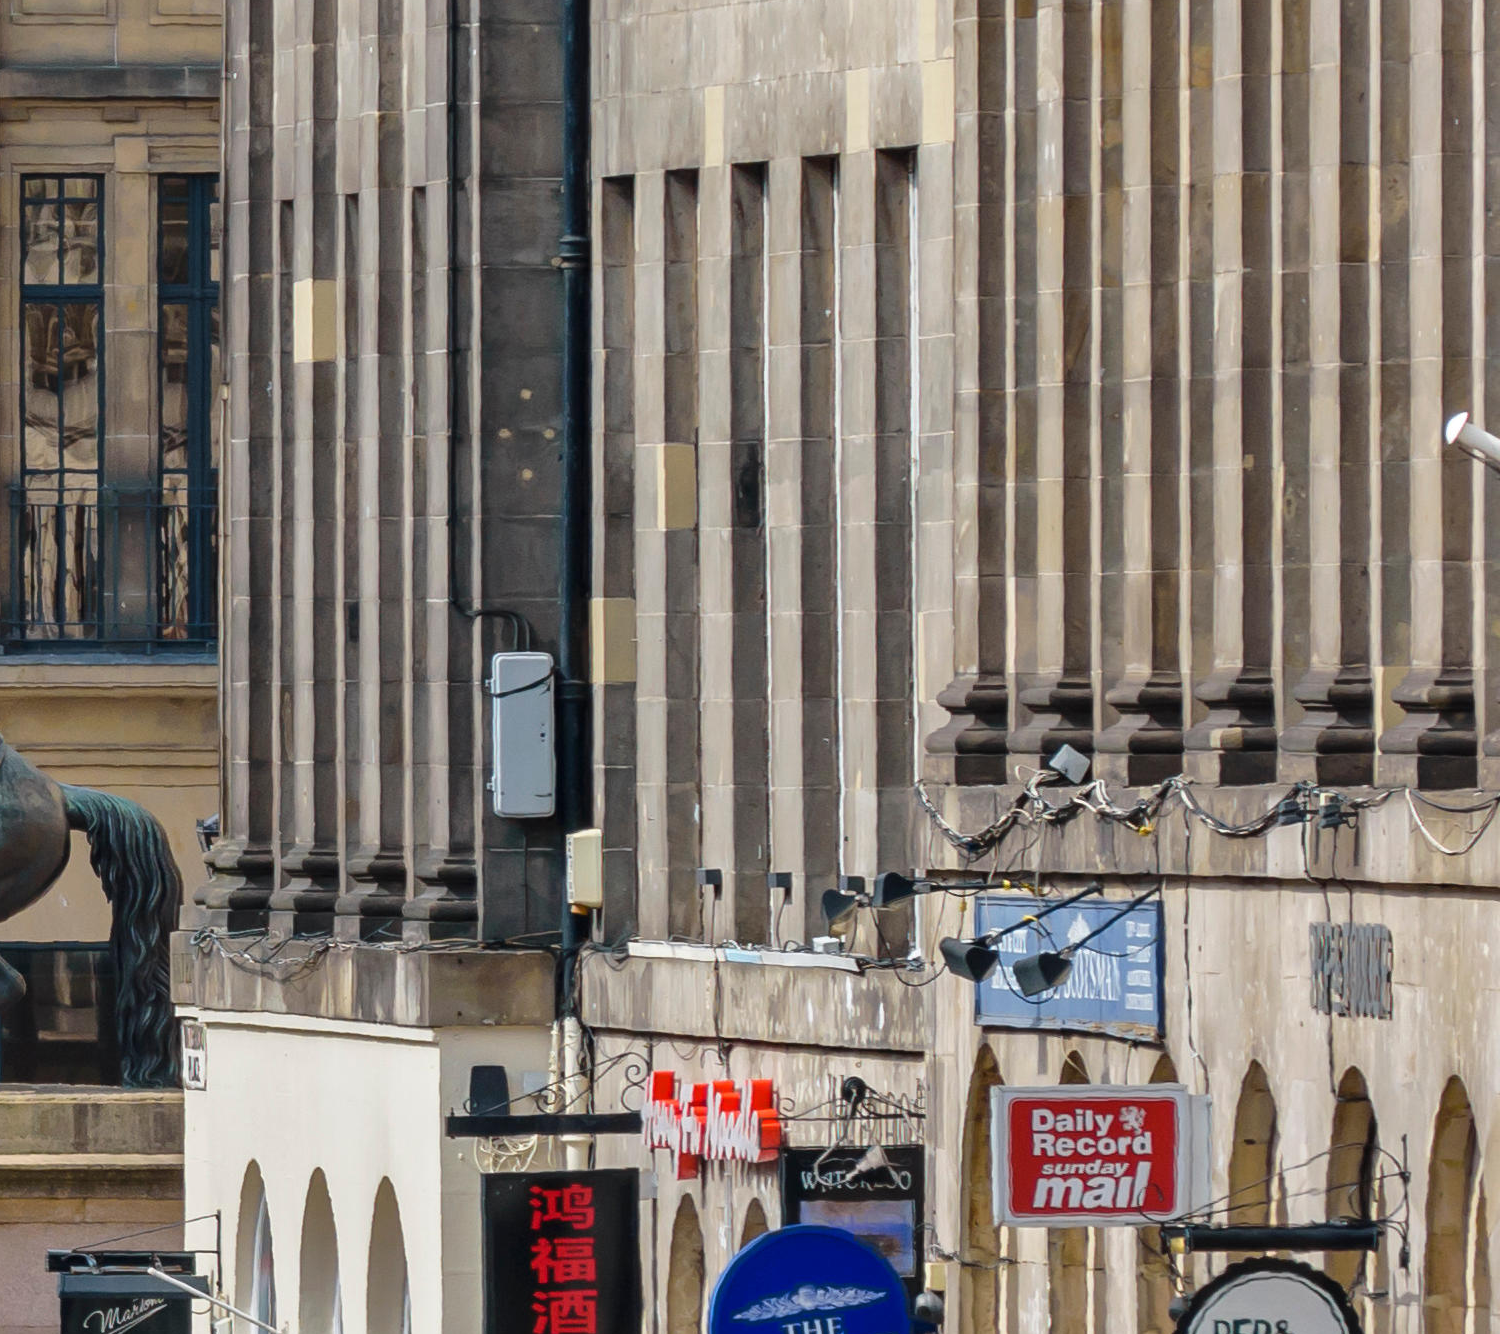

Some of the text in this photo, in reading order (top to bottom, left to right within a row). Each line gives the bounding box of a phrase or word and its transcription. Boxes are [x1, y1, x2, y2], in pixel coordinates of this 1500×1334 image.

[1031, 1108, 1115, 1137] Daily
[1032, 1131, 1153, 1157] Record
[1041, 1159, 1130, 1178] sunday
[1032, 1160, 1153, 1209] mail
